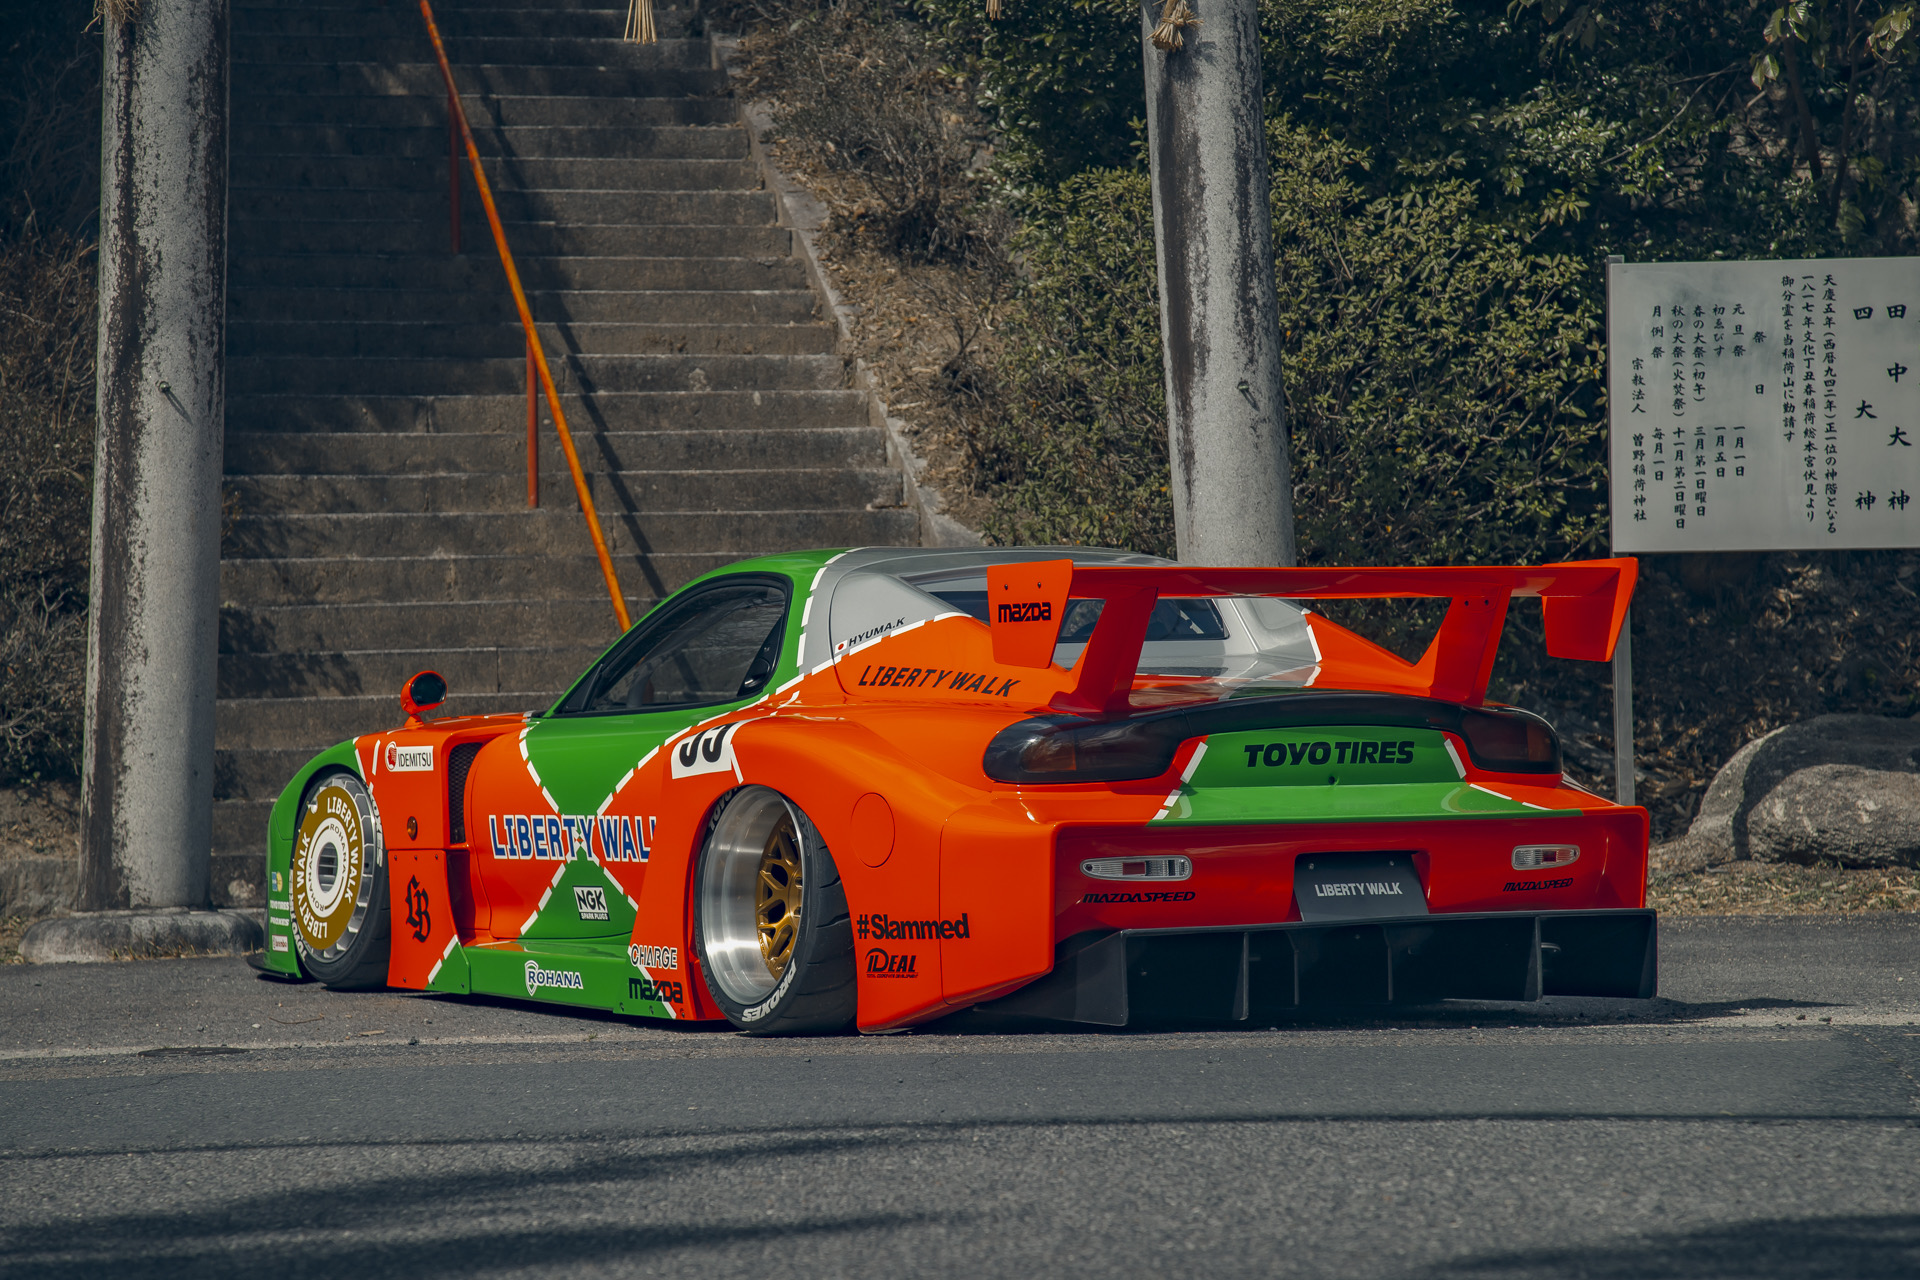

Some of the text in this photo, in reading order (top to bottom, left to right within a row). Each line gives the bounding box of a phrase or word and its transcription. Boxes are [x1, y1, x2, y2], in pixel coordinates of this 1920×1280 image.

[848, 616, 906, 647] HYUMA.K
[857, 664, 1022, 698] LIBERTY WALK
[397, 752, 433, 768] IDEMITSU
[327, 795, 359, 904] LIBERTY WALK
[489, 814, 596, 862] LIBERTY
[296, 831, 329, 940] LIBERTY WALK
[575, 889, 606, 911] NGK
[1314, 882, 1404, 897] LIBERTY WALK
[856, 912, 971, 940] #Slammed
[630, 943, 678, 970] CHARGE
[526, 968, 584, 990] ROHANA
[741, 957, 797, 1022] PROXES
